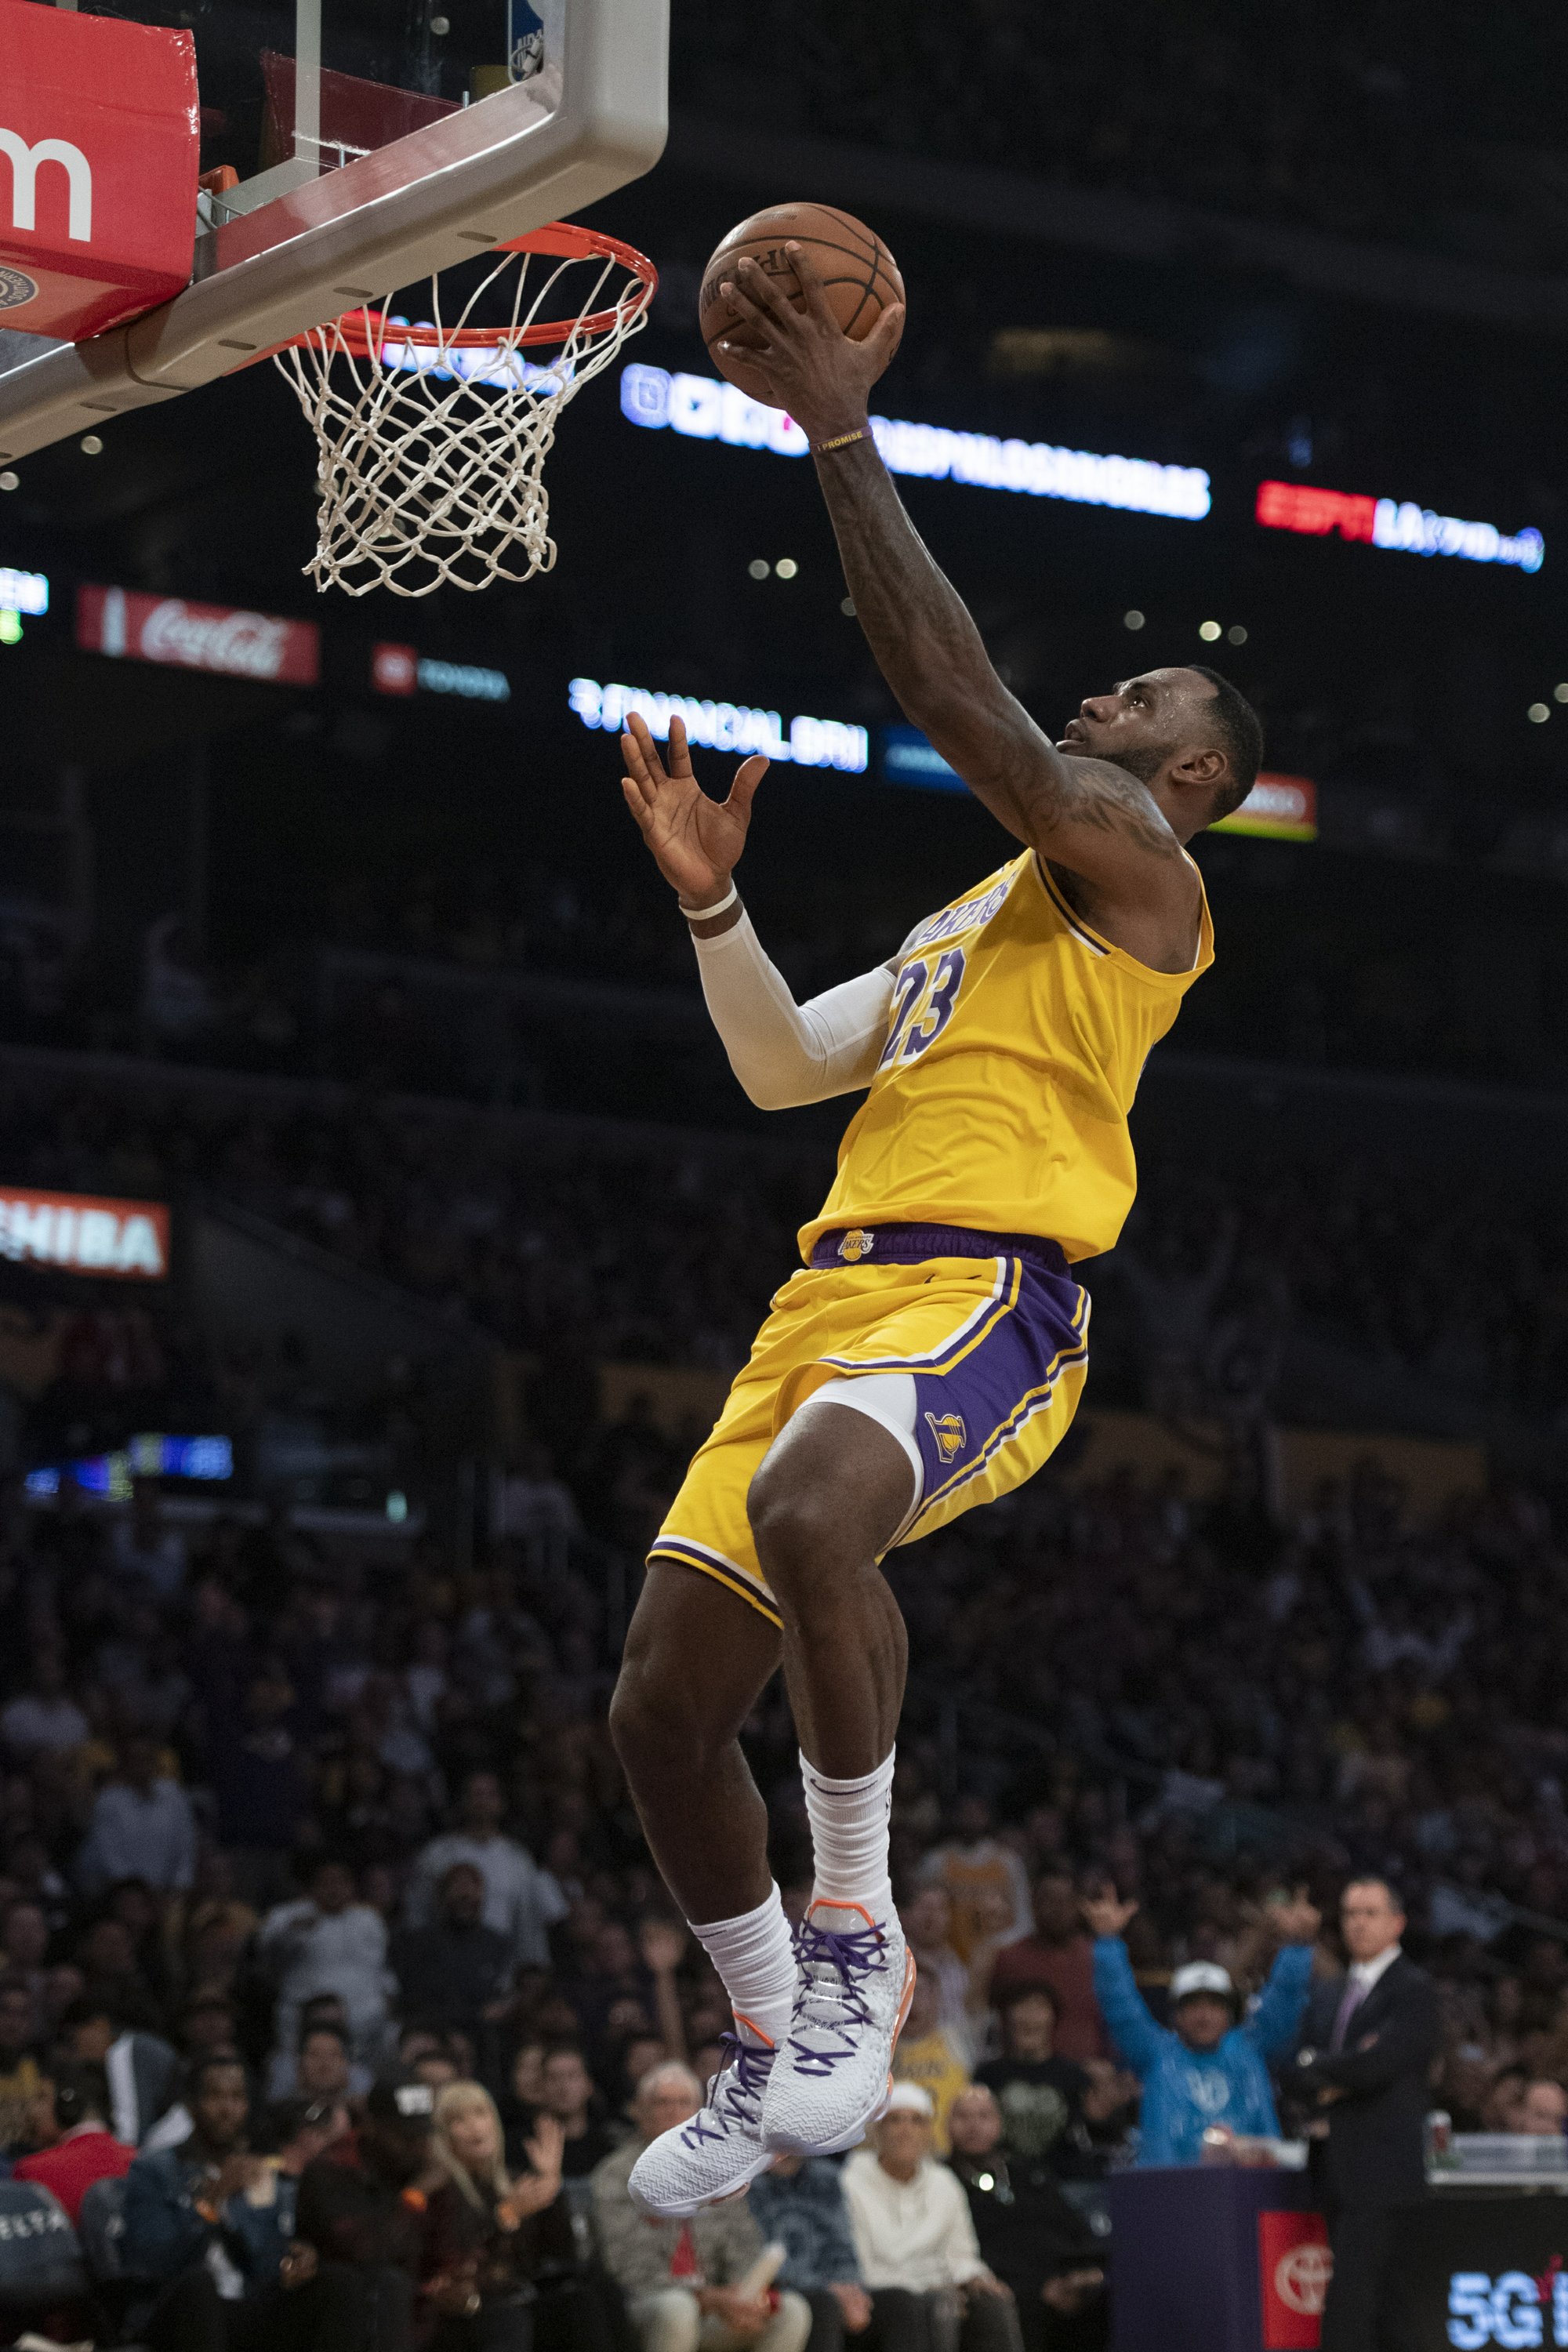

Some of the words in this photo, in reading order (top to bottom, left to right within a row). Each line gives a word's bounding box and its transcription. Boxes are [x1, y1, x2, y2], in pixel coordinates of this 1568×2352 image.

[822, 431, 862, 451] PROMISE
[911, 869, 1018, 952] AKERS
[877, 946, 966, 1072] 23
